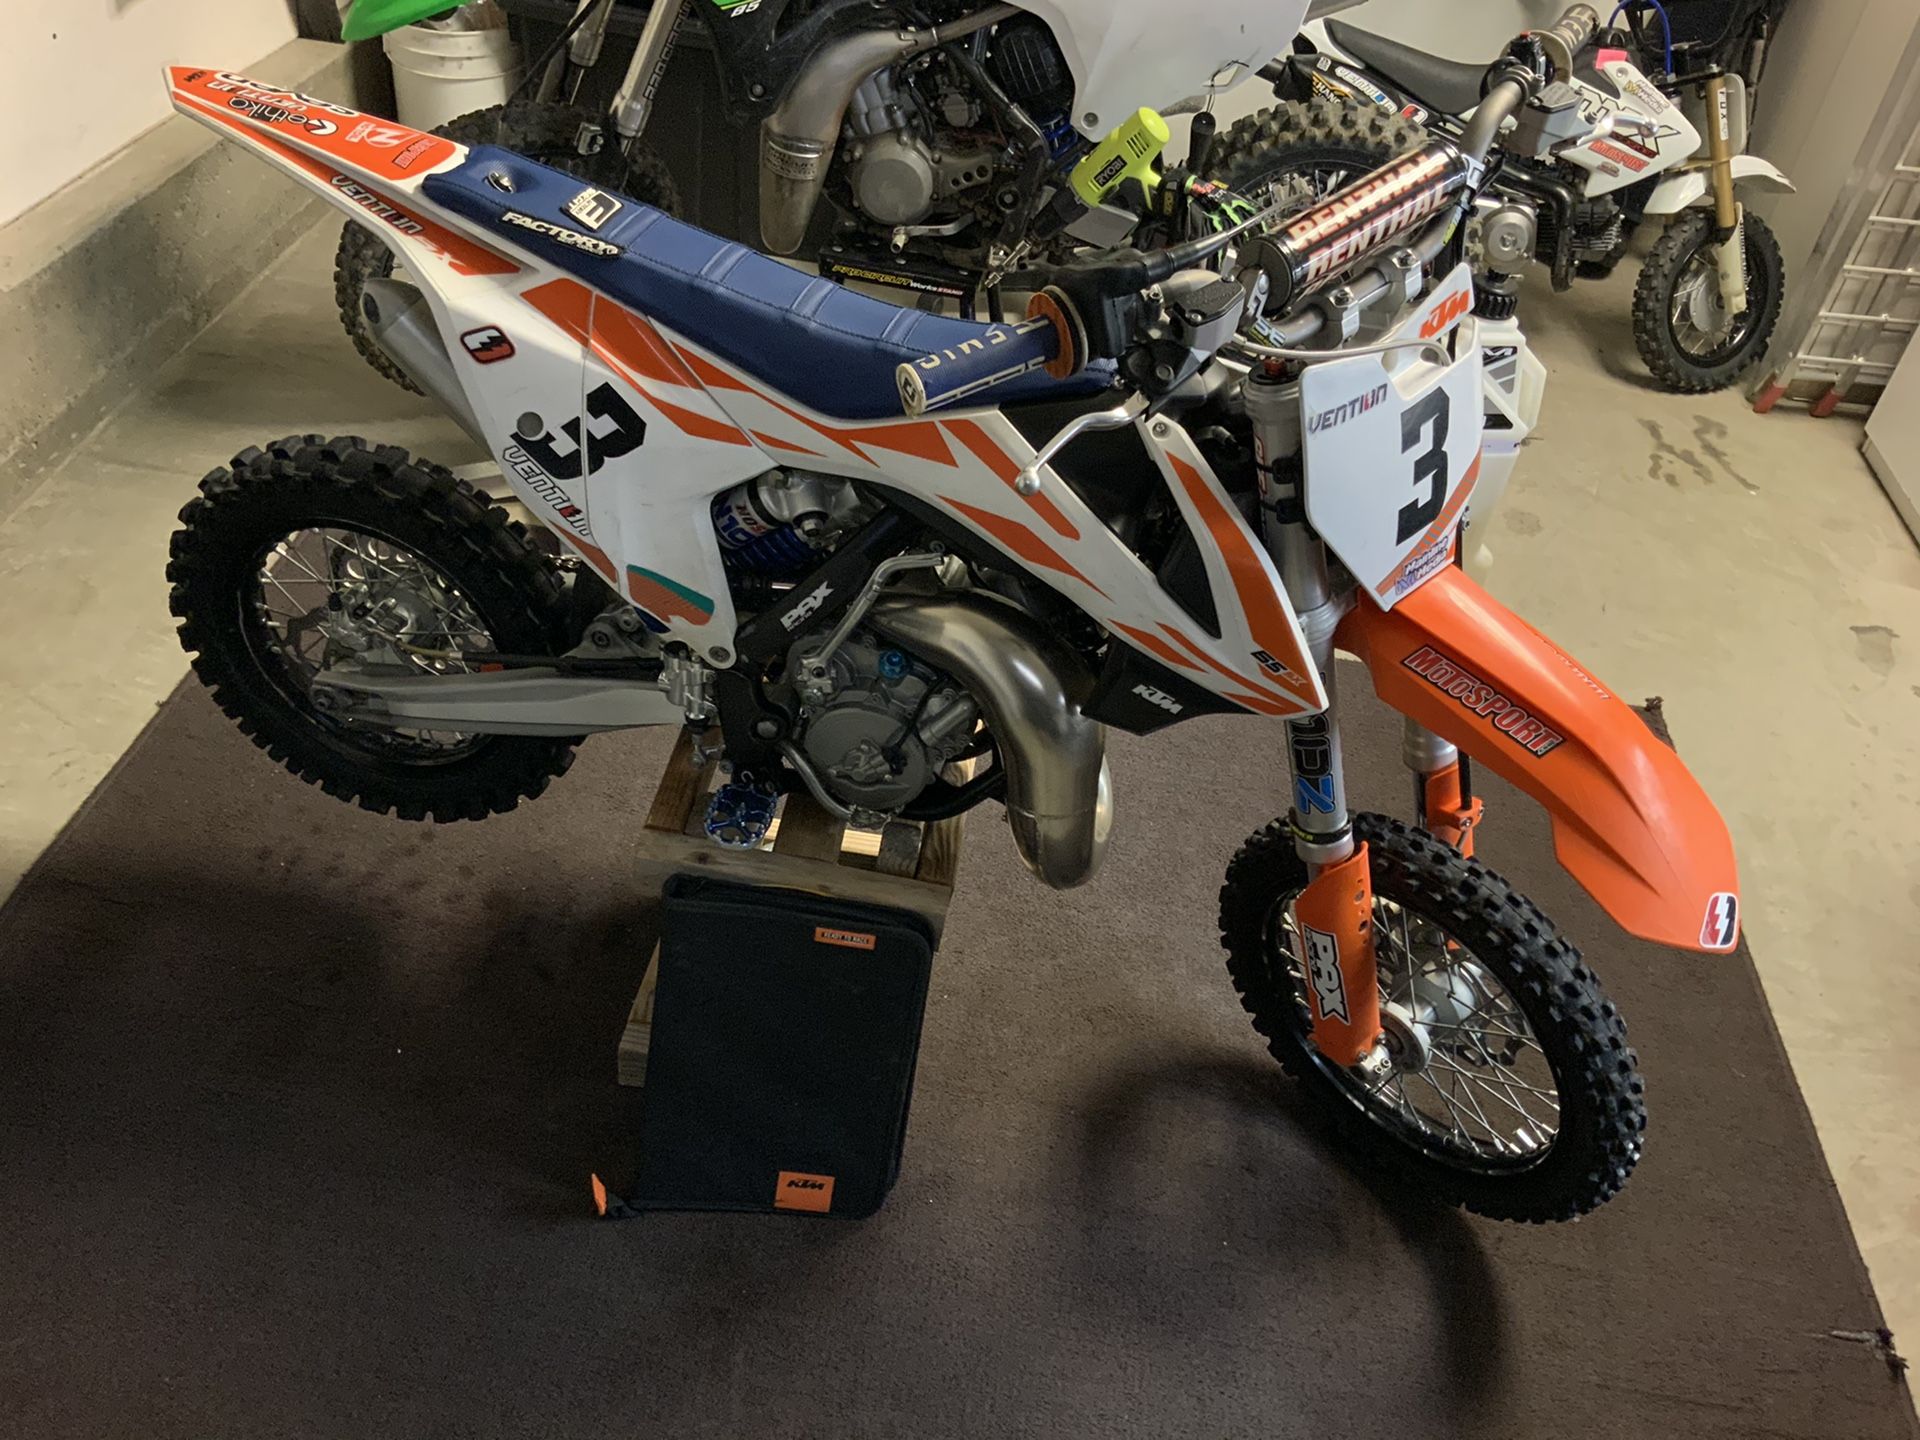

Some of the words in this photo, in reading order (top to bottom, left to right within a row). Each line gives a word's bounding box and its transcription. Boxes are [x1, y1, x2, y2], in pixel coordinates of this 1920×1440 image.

[730, 0, 761, 18] 85
[1098, 157, 1126, 186] RYOBI
[502, 211, 606, 255] FACTORY
[1305, 181, 1449, 284] RENTHAL
[1419, 290, 1470, 339] KTM
[509, 381, 648, 481] 3
[1396, 385, 1450, 547] 3
[1131, 684, 1184, 715] KTM
[787, 1178, 825, 1192] KTM
